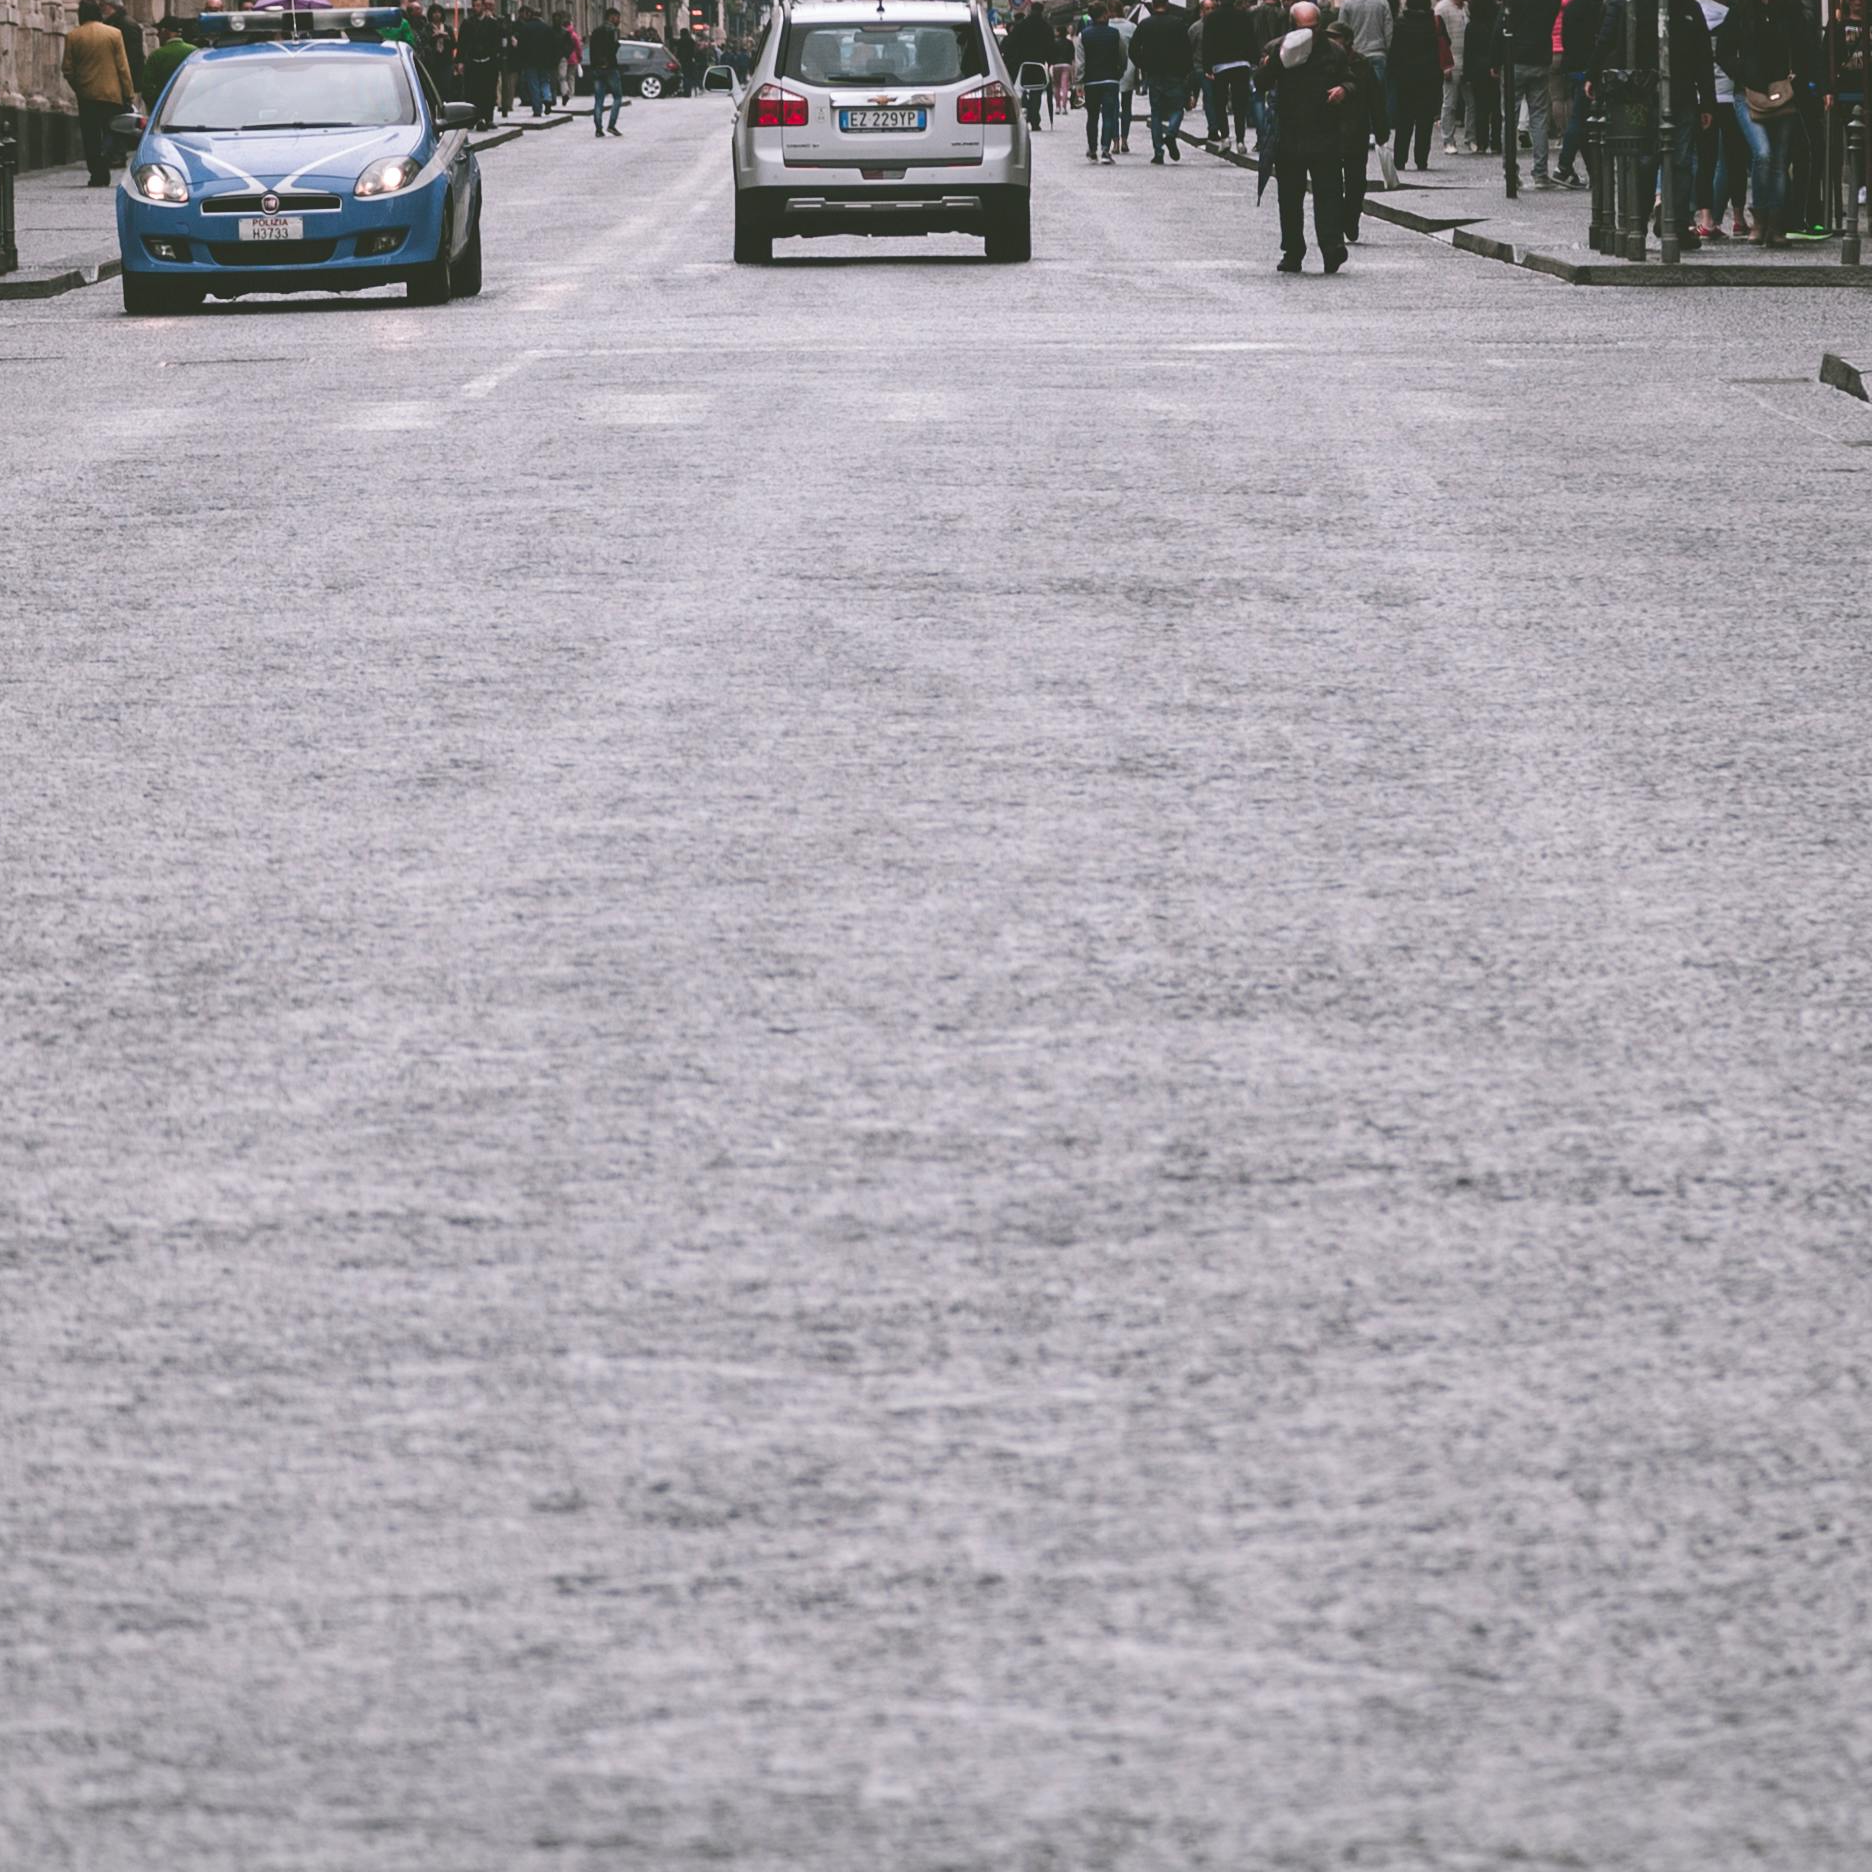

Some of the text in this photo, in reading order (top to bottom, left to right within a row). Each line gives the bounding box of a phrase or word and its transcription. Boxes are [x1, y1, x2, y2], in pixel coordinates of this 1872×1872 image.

[850, 112, 868, 127] EZ
[872, 111, 917, 127] 229YP
[252, 218, 289, 226] POLIZIA
[252, 227, 289, 240] H3733
